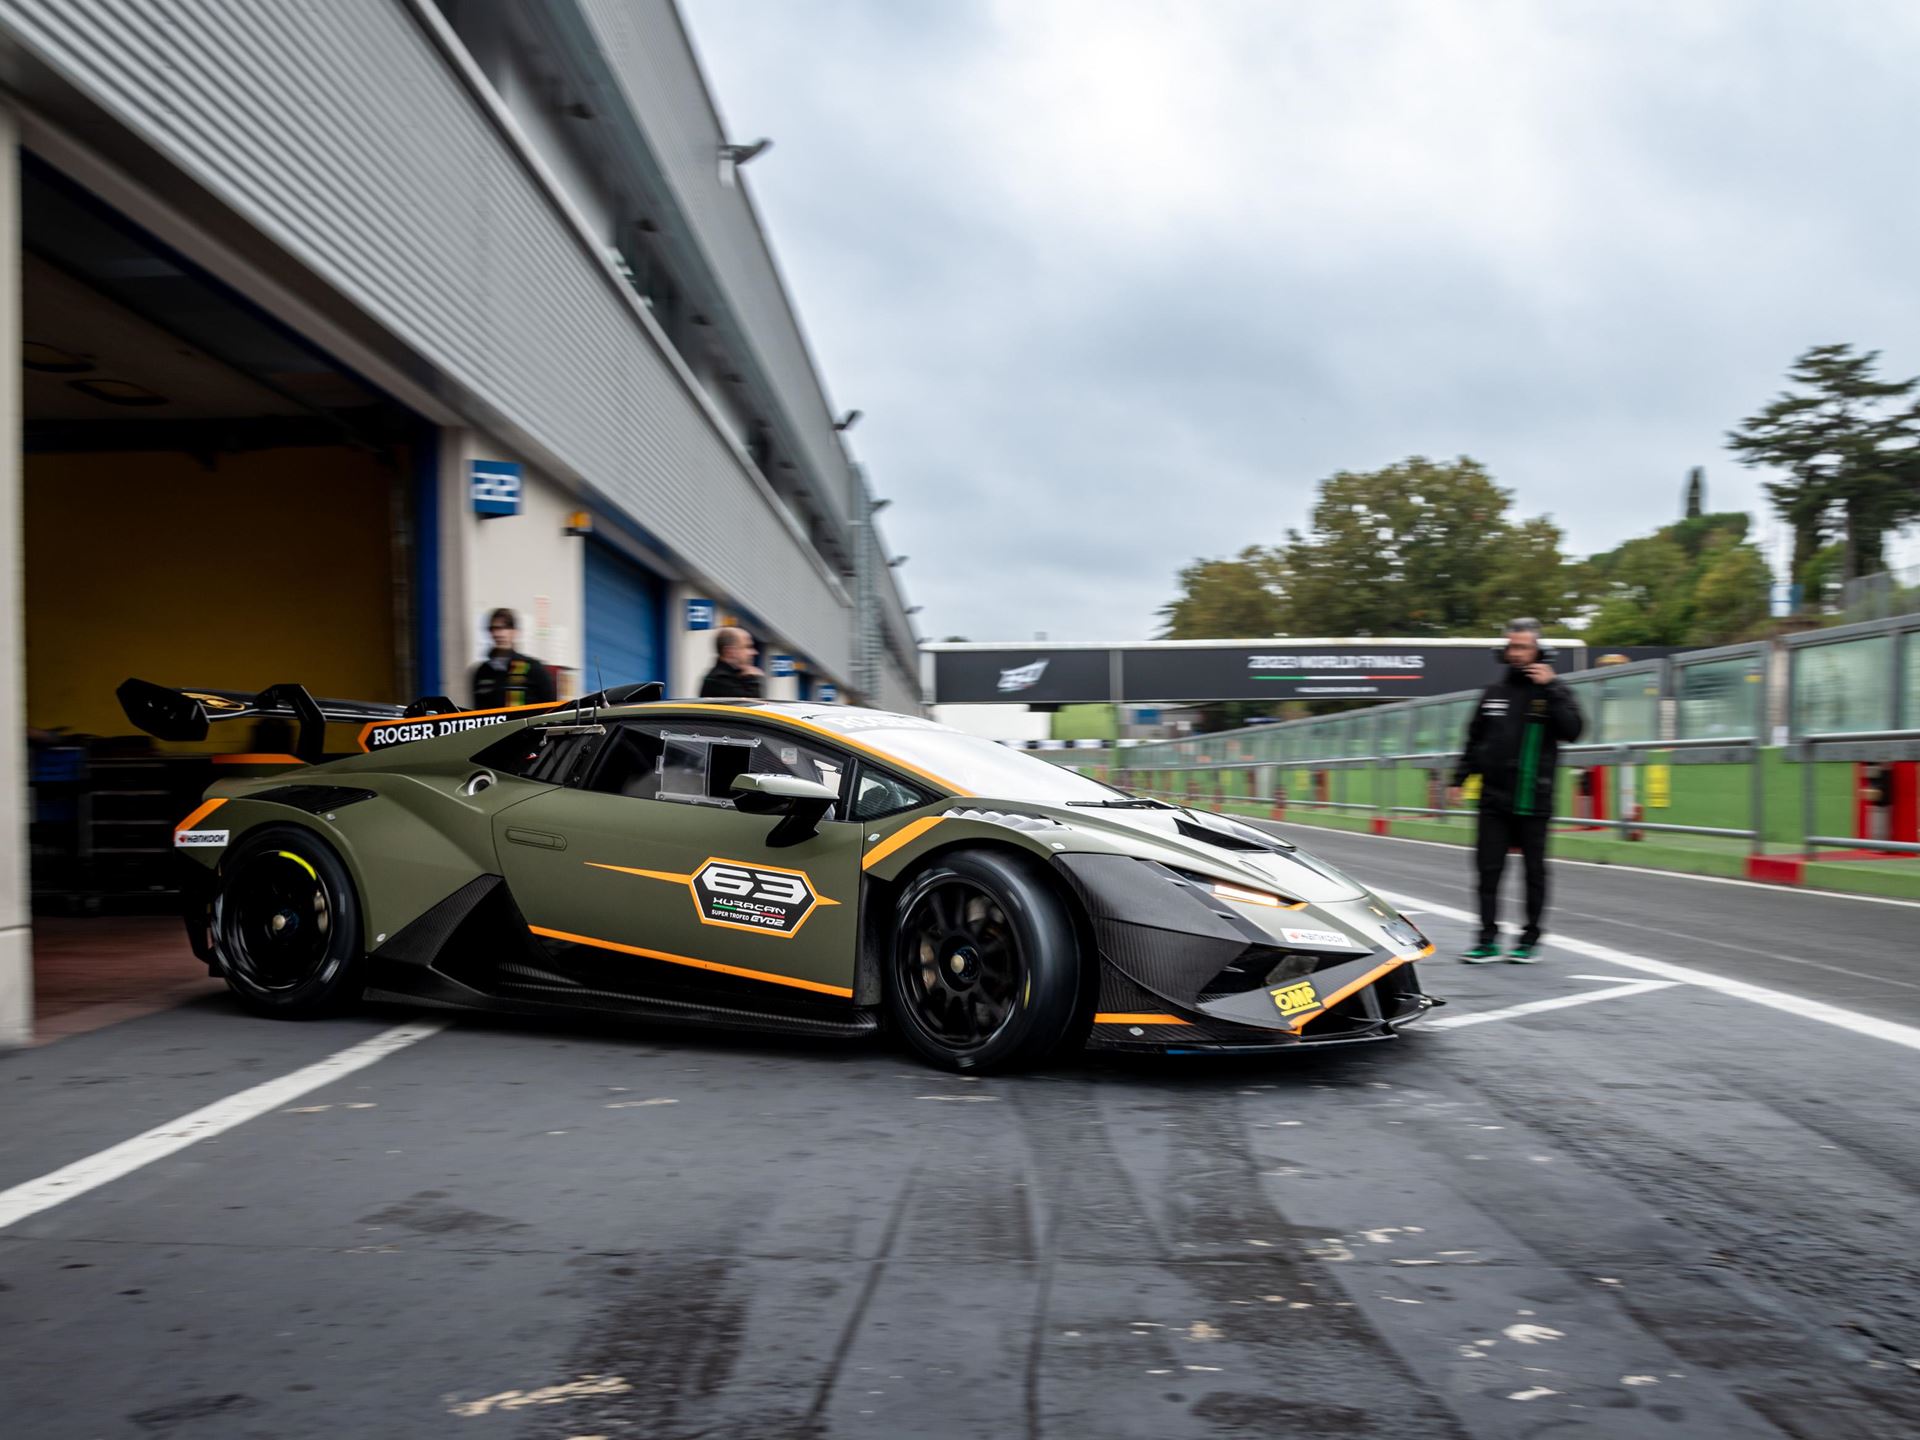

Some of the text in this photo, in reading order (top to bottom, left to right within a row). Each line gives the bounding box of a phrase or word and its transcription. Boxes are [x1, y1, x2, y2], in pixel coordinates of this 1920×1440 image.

[470, 472, 521, 502] 22
[373, 724, 435, 745] ROGER
[702, 866, 807, 905] 63
[711, 909, 786, 927] SUPER TROFEO EVO2
[1274, 986, 1316, 1010] OMP
